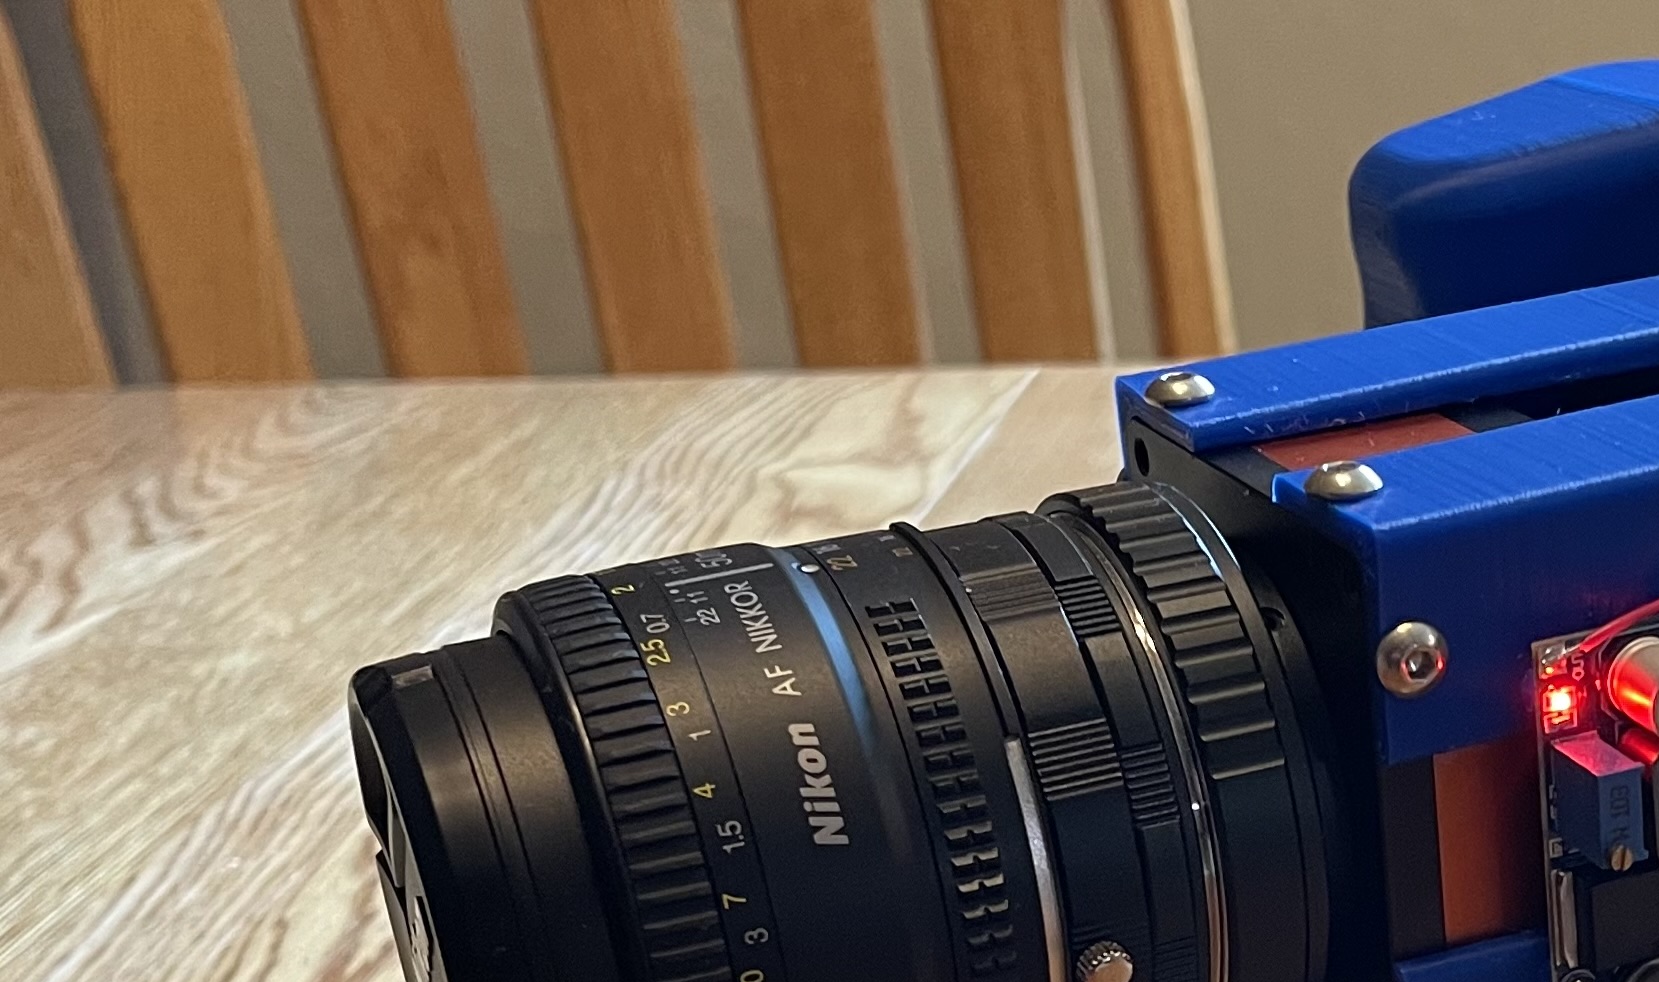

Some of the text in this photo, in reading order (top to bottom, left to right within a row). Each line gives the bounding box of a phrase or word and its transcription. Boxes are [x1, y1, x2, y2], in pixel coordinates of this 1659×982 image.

[611, 584, 636, 595] 2
[639, 613, 671, 634] 0.7
[696, 607, 721, 626] 22
[666, 701, 690, 717] 3
[723, 580, 850, 846] Nikon AF NIKKOR
[687, 729, 712, 742] 1
[692, 782, 716, 799] 4
[714, 820, 745, 854] 1.5
[721, 893, 747, 910] 7
[744, 927, 769, 945] 3
